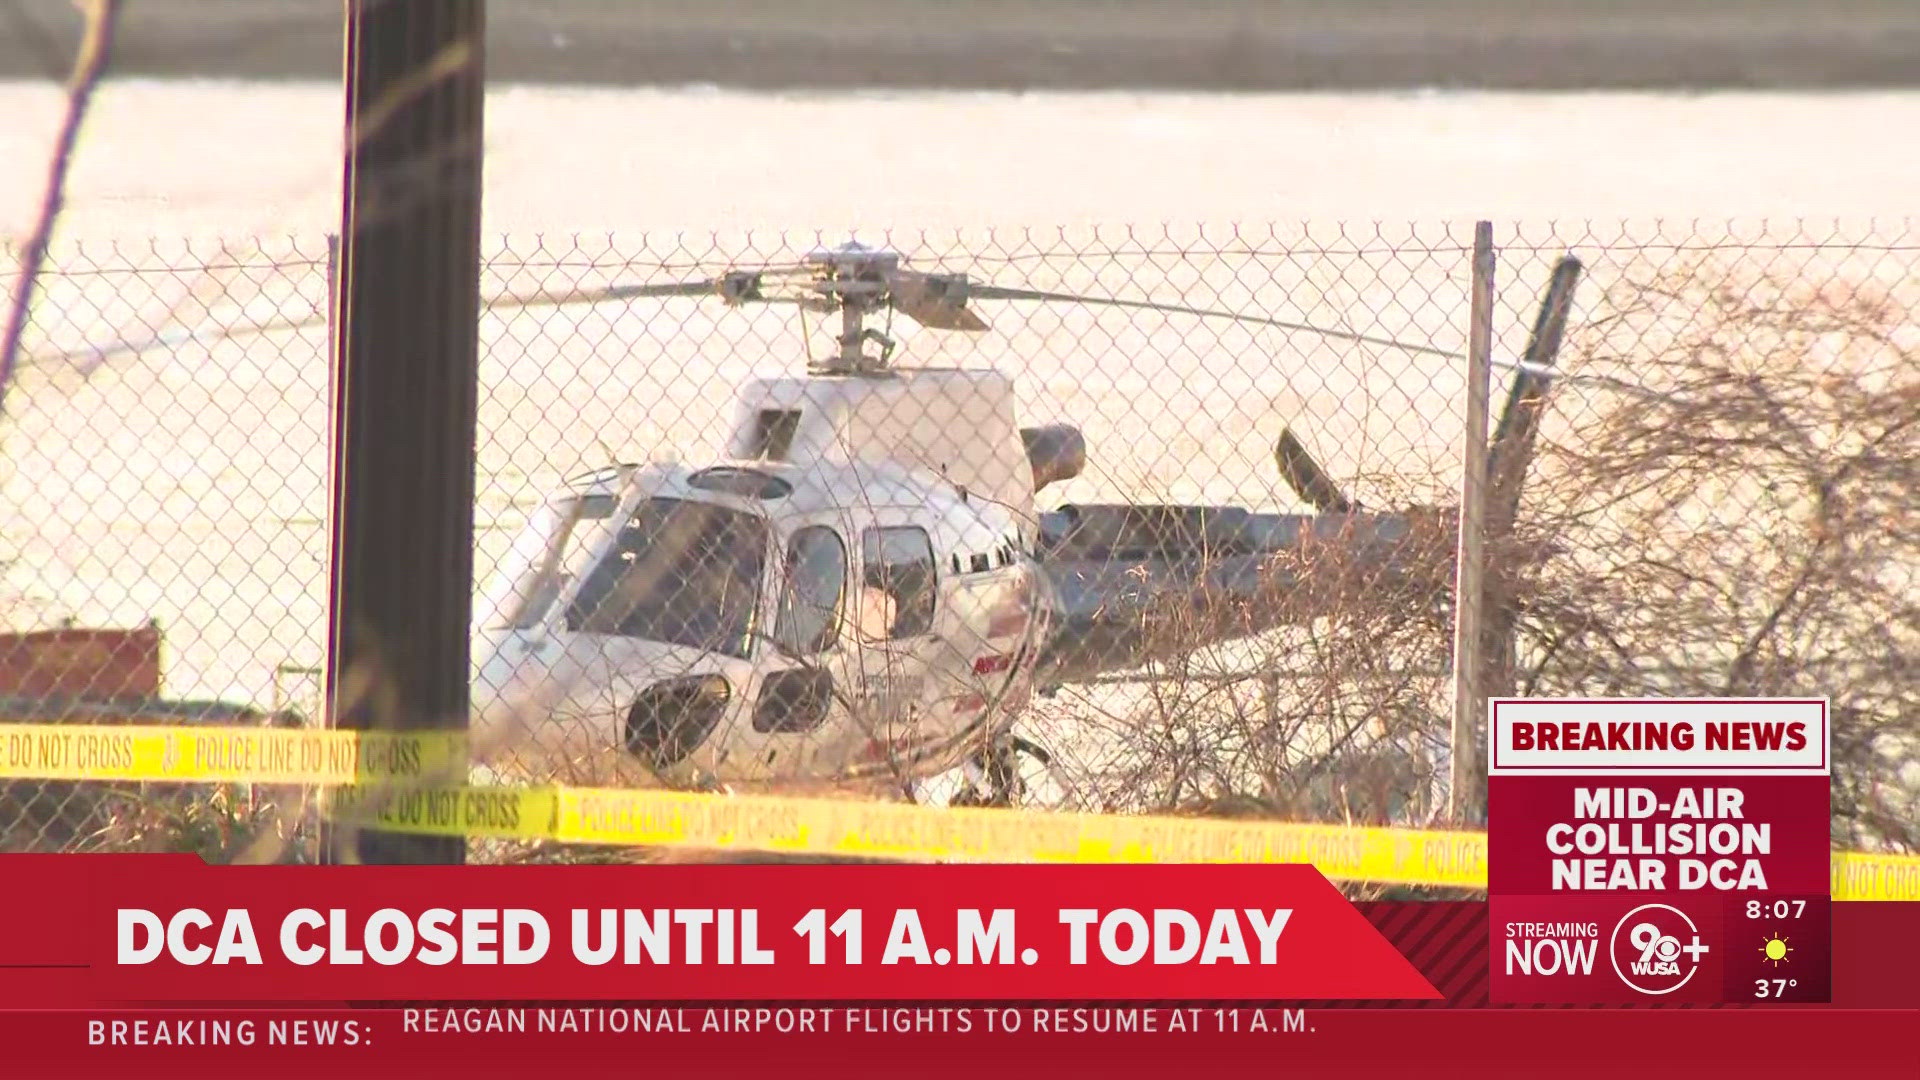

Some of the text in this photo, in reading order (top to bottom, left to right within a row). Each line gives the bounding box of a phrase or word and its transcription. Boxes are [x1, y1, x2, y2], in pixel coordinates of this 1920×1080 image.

[9, 733, 32, 769] DO
[37, 733, 70, 769] NOT
[77, 734, 133, 770] CROSS
[196, 736, 251, 772] POLICE
[258, 738, 294, 774] LINE
[301, 739, 322, 773] DO
[399, 789, 421, 825] DO
[427, 790, 460, 826] NOT
[464, 791, 520, 830] CROSS
[581, 797, 635, 834] POLICE
[640, 801, 677, 835] LINE
[1424, 839, 1486, 876] POLICE
[1847, 861, 1879, 897] NOT
